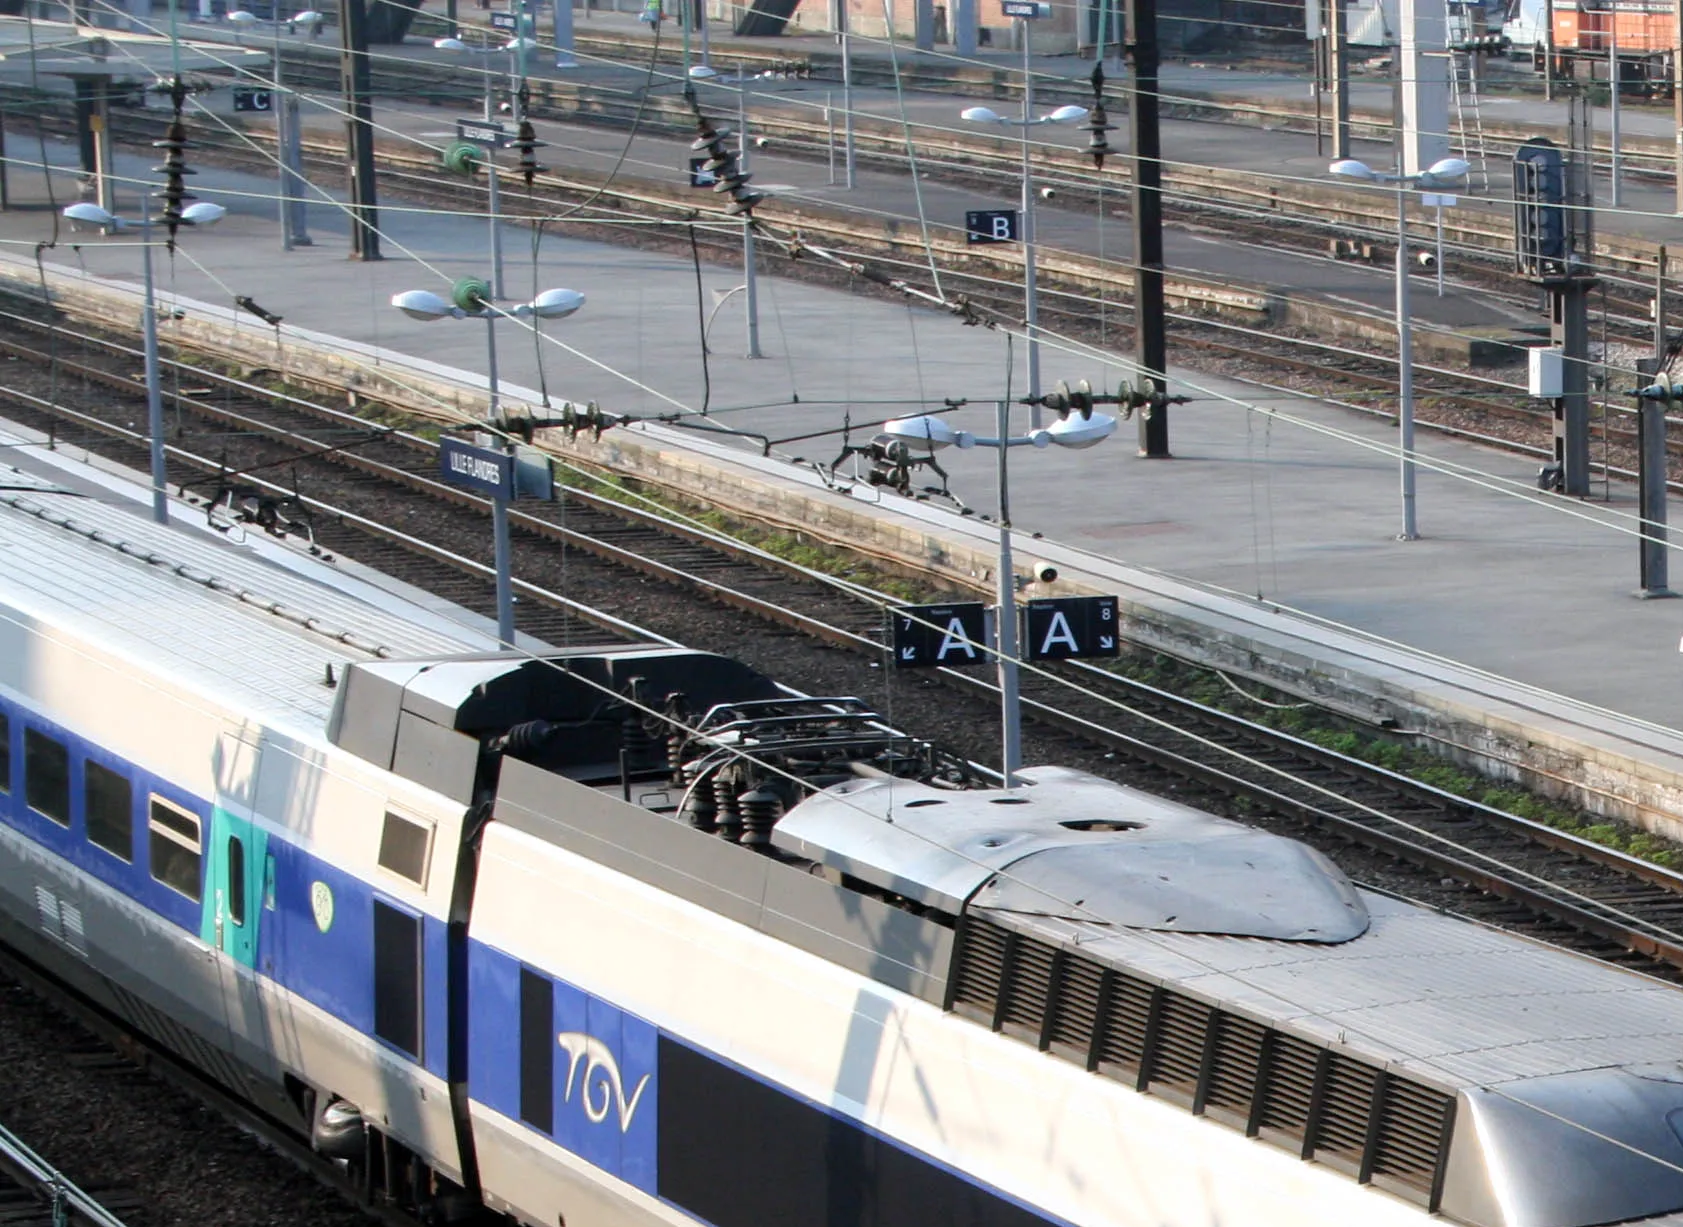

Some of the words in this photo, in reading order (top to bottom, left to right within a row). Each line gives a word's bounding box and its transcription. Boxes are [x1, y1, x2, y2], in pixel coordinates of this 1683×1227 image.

[993, 216, 1010, 240] B
[902, 618, 912, 631] 7
[1102, 607, 1111, 621] 8
[937, 617, 977, 660] A
[1041, 611, 1079, 653] A
[558, 1032, 651, 1133] TGV
